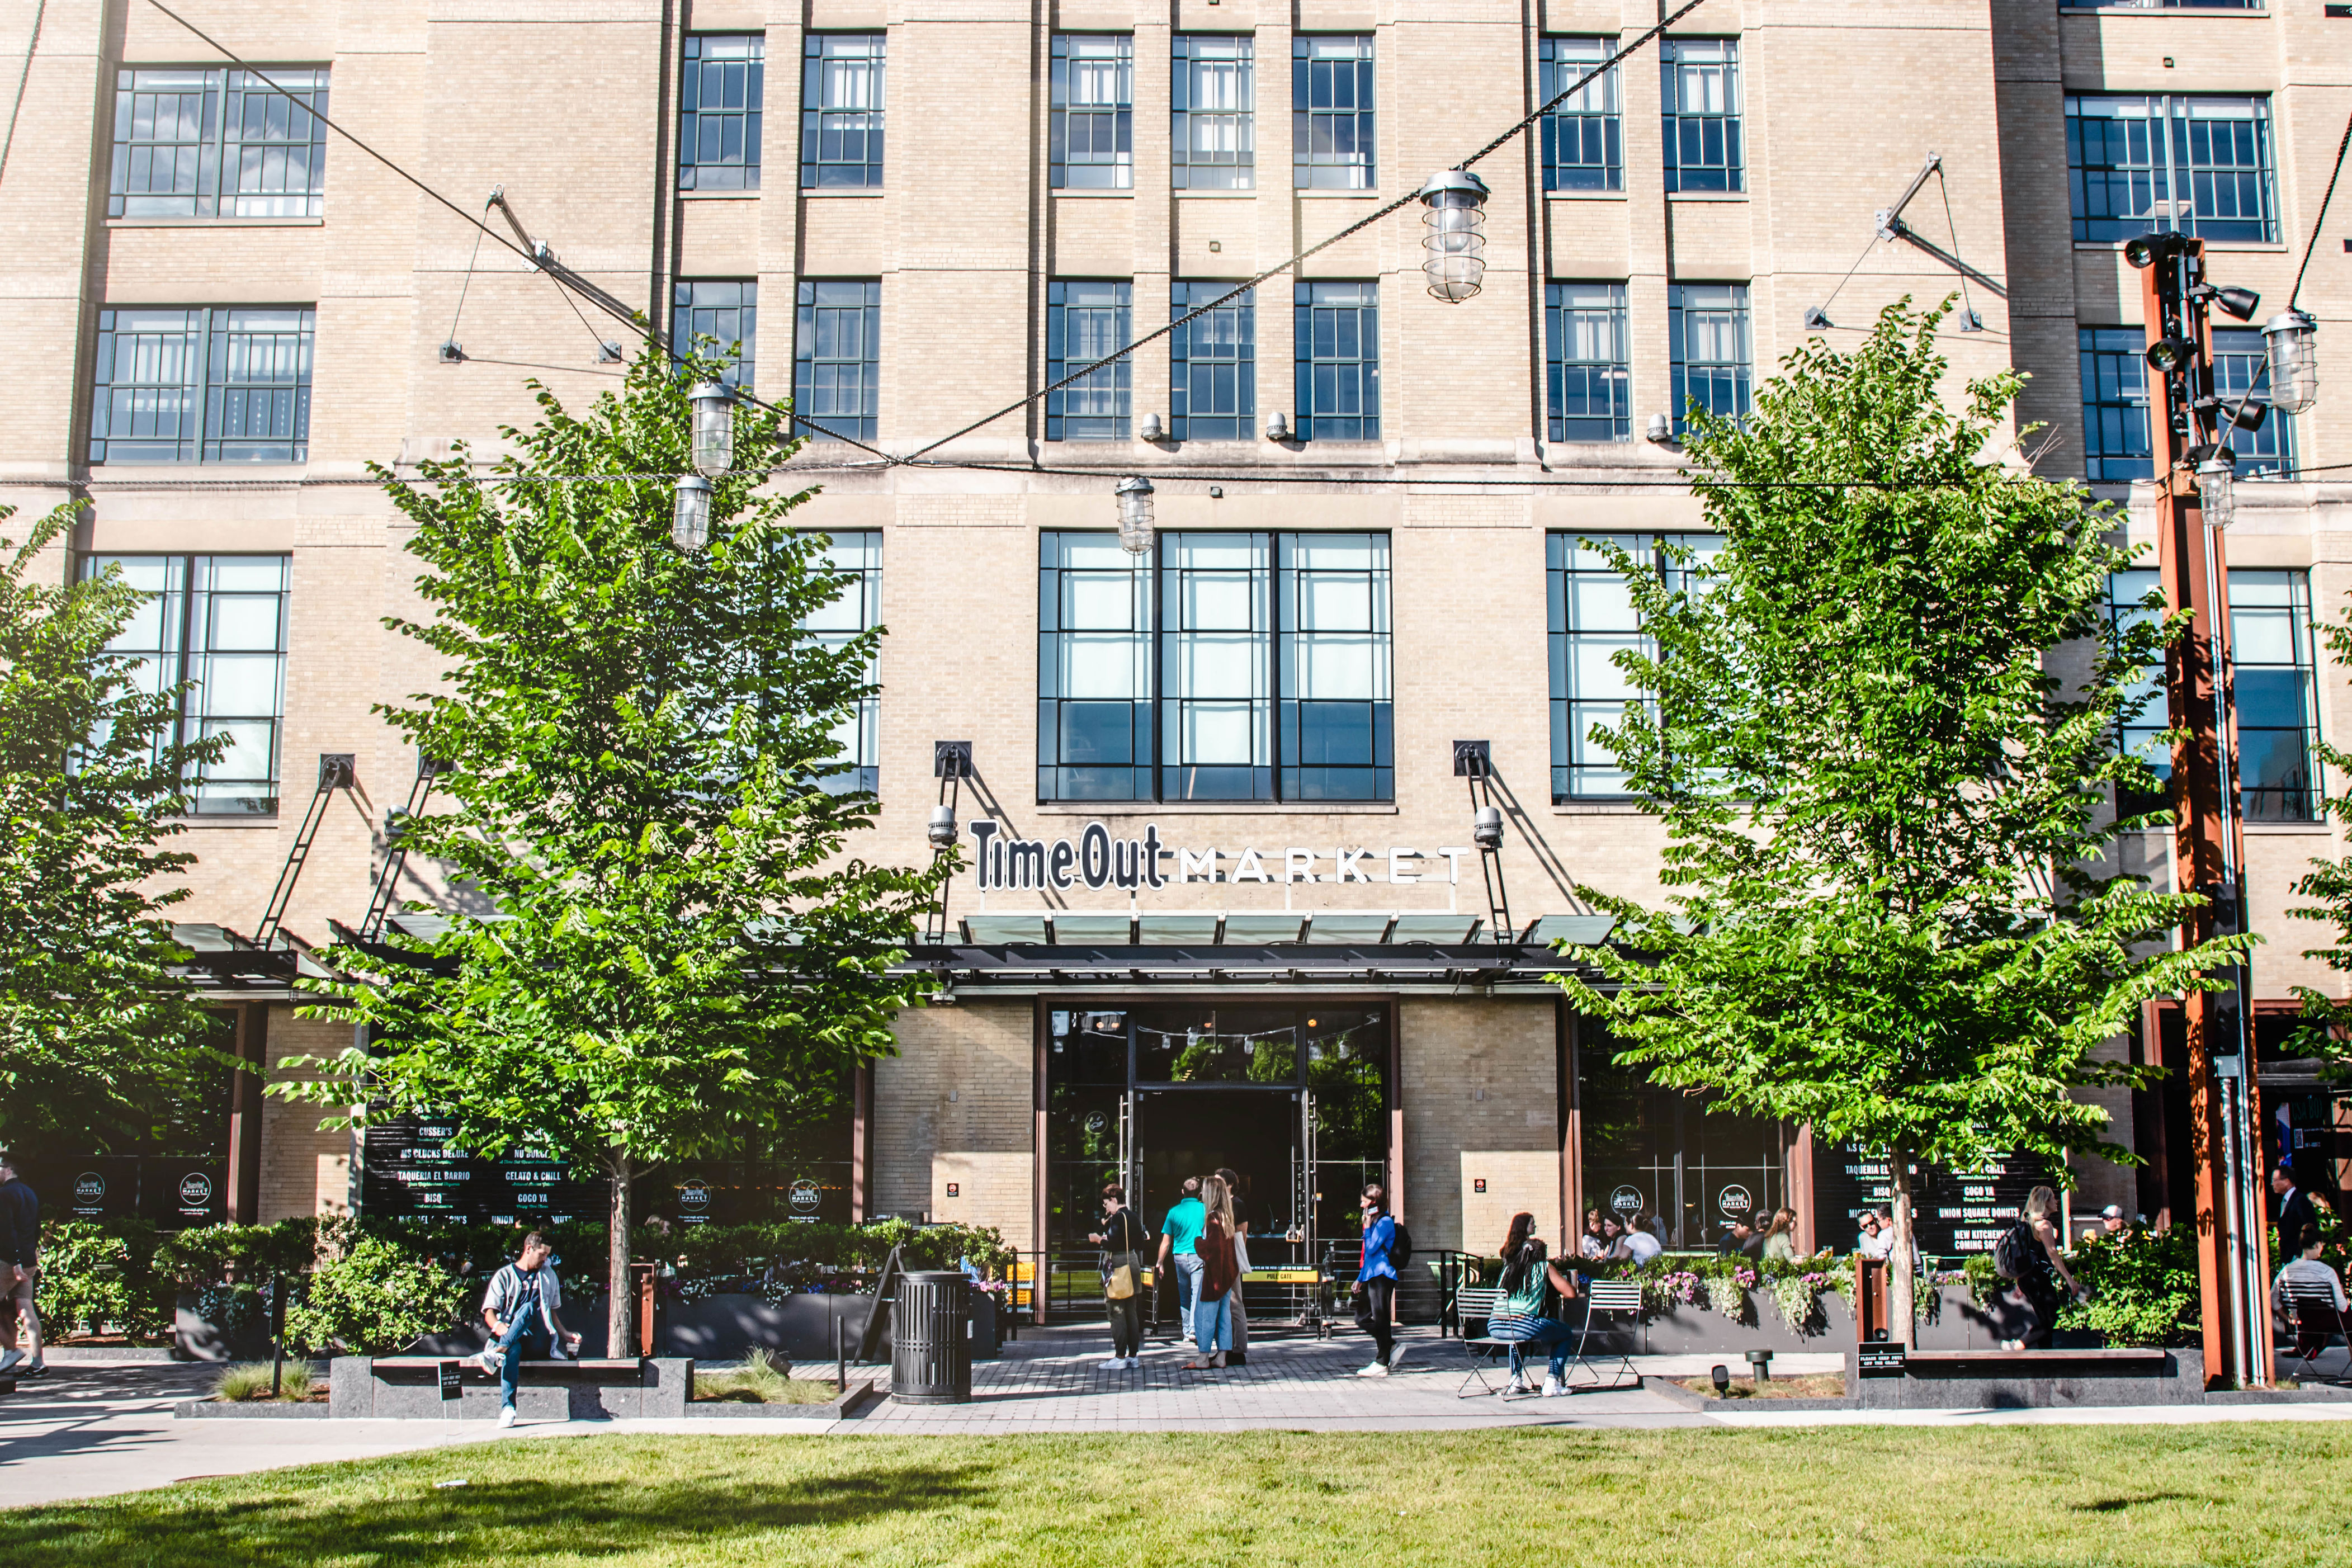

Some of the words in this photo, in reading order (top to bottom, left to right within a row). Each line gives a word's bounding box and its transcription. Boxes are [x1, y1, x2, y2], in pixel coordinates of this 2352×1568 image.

[1179, 846, 1470, 885] MARKET
[419, 1126, 452, 1136] CUSSER'S
[400, 1149, 412, 1159] MS
[413, 1149, 441, 1159] CLUCKS
[442, 1149, 469, 1159] DELUXE
[514, 1149, 525, 1158] NU
[1845, 1164, 1879, 1175] TAQUERIA
[1879, 1164, 1890, 1174] EL
[398, 1171, 432, 1181] TAQUERIA
[433, 1171, 442, 1180] EL
[444, 1171, 470, 1180] BARRIO
[506, 1171, 531, 1181] GELATO
[533, 1172, 539, 1180] &
[541, 1172, 561, 1181] CHILL
[1873, 1186, 1891, 1198] BISQ
[1964, 1186, 1984, 1196] GOGO
[1984, 1186, 1995, 1196] YA
[424, 1193, 442, 1204] BISQ
[518, 1193, 537, 1203] GOGO
[539, 1193, 547, 1203] YA
[1939, 1207, 1962, 1218] UNION
[1962, 1207, 1991, 1218] SQUARE
[1991, 1207, 2020, 1218] DONUTS
[1954, 1229, 1971, 1240] NEW
[1954, 1240, 1983, 1250] COMING
[1983, 1240, 1998, 1250] SOO
